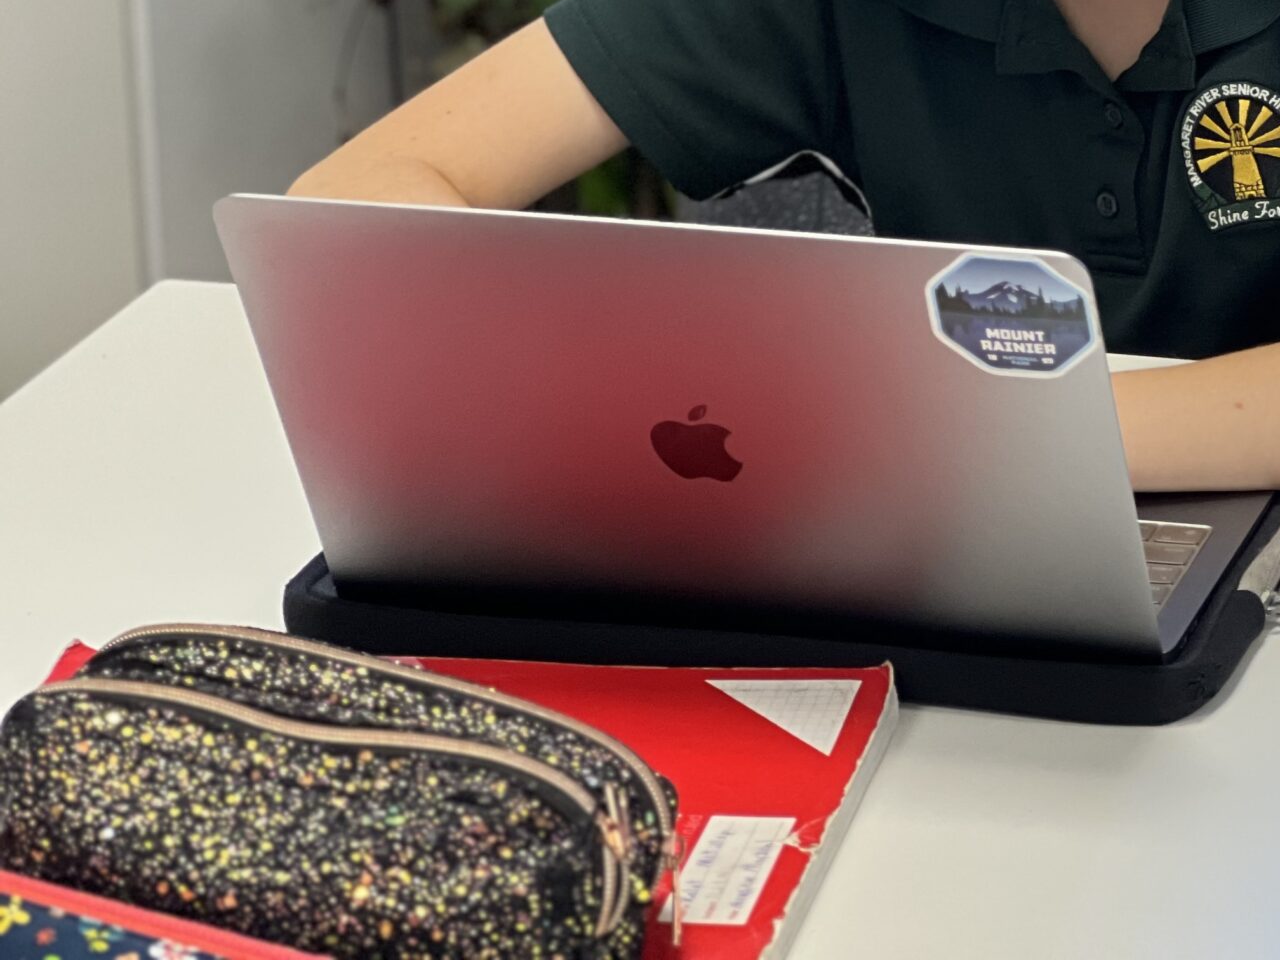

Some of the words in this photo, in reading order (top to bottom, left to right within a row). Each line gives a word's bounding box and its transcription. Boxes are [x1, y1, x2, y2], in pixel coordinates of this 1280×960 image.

[1189, 88, 1221, 117] RIVER
[1221, 83, 1270, 102] SENIOR
[1181, 115, 1202, 187] MARGARET
[1208, 209, 1249, 230] Shine
[985, 328, 1045, 342] MOUNT
[980, 339, 1057, 355] RAINIER
